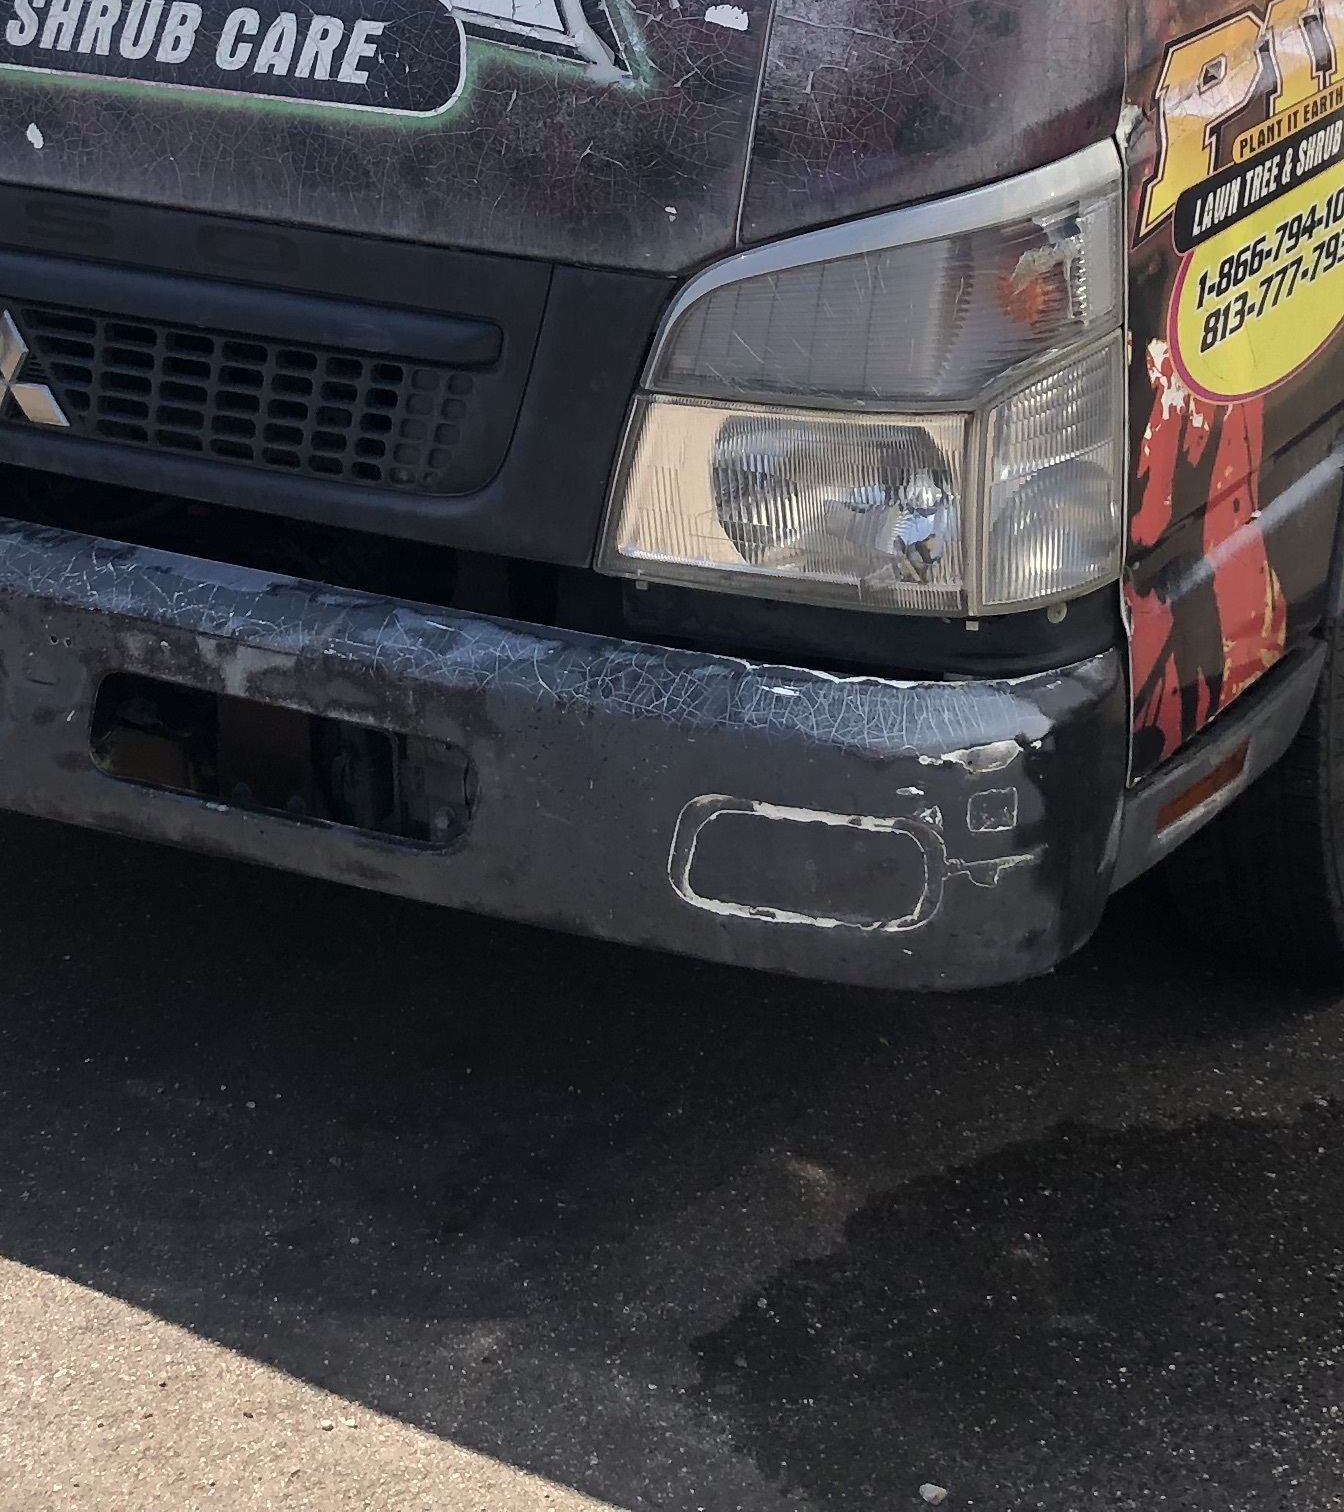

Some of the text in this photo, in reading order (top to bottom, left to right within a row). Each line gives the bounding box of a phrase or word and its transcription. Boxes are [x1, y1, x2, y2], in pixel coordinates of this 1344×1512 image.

[215, 4, 385, 85] CARE
[1239, 86, 1343, 159] PLANT IT EARTH
[1192, 172, 1242, 238] LAWN
[1243, 154, 1281, 208] TREE
[1281, 148, 1294, 184] &
[1297, 119, 1343, 178] SHRUB
